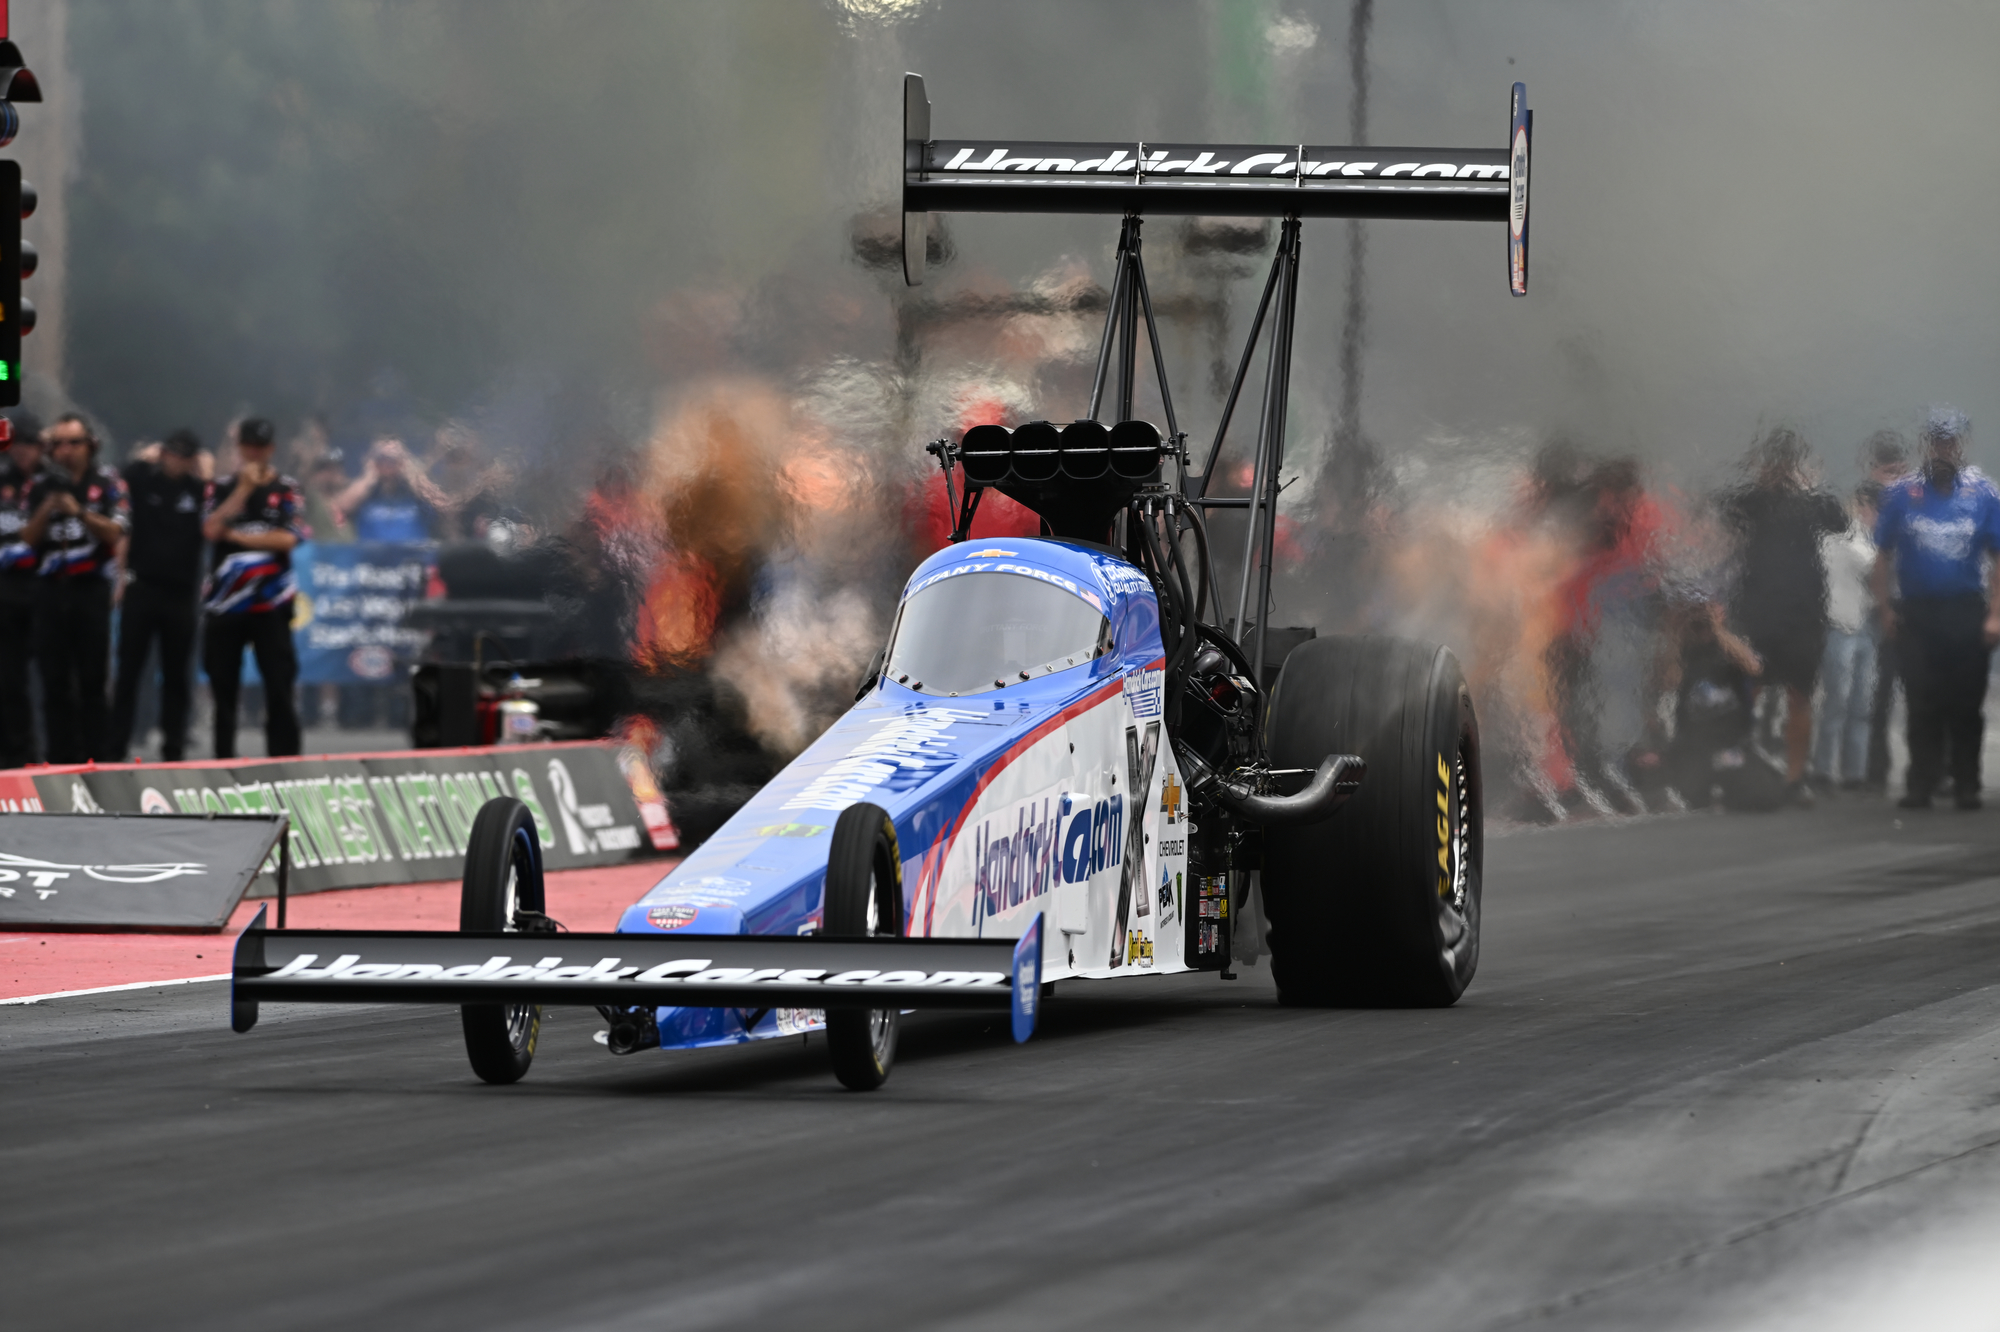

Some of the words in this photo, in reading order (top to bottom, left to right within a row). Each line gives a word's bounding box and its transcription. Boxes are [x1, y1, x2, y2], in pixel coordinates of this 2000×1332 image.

[996, 563, 1077, 593] FORCE
[1436, 751, 1450, 898] EAGLE
[1159, 839, 1185, 857] CHEVROLET
